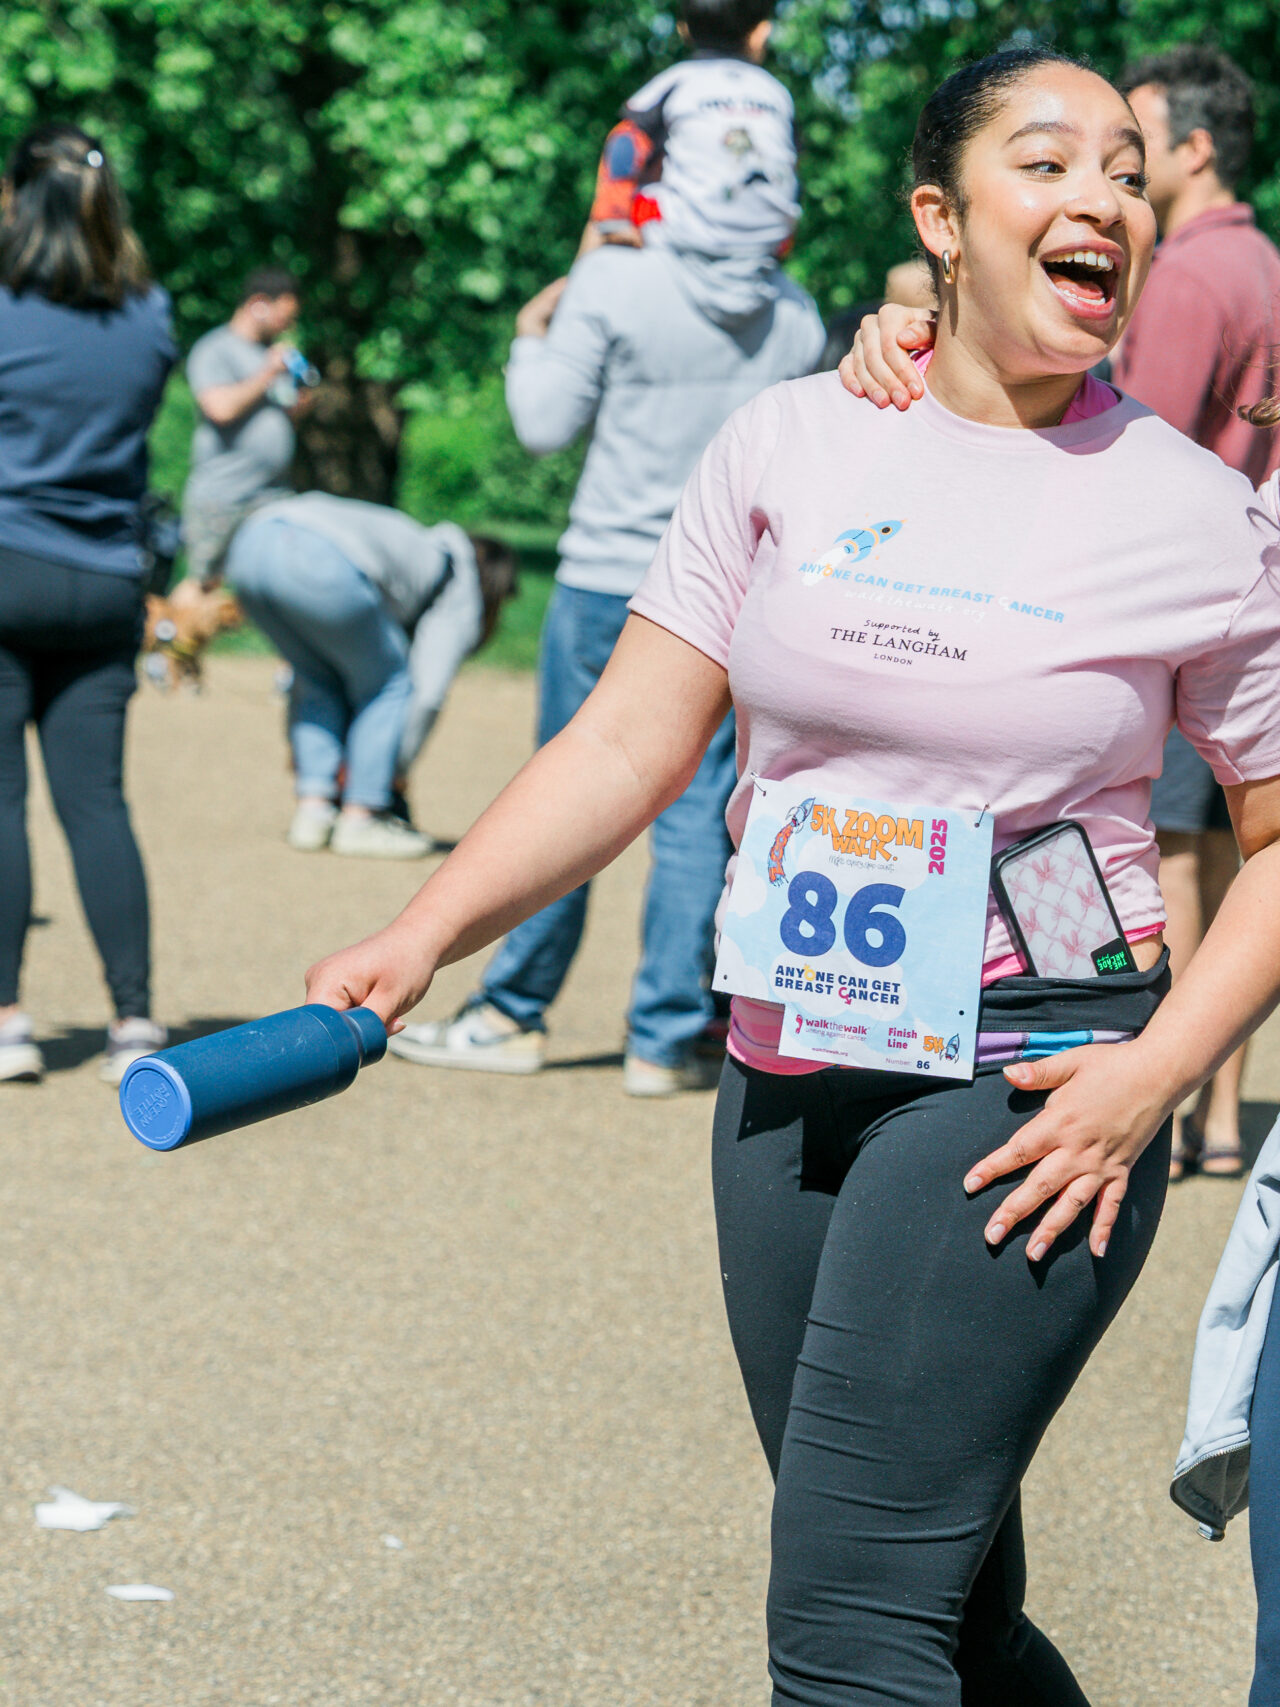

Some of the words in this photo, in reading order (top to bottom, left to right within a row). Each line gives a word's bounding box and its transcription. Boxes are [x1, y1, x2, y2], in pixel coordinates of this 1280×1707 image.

[798, 562, 851, 581] ANYONE
[854, 573, 888, 588] CAN
[893, 582, 926, 595] GET
[929, 586, 995, 605] BREAST
[998, 596, 1065, 623] CANCER
[864, 619, 921, 635] Supported
[928, 628, 940, 642] by
[830, 627, 867, 644] THE
[872, 635, 968, 661] LANGHAM
[873, 653, 913, 665] LONDON
[810, 804, 841, 838] 5K
[842, 809, 924, 850] ZOOM
[928, 819, 948, 875] 2025
[780, 870, 907, 968] 86
[775, 977, 834, 995] BREAST
[838, 987, 899, 1005] CANCER
[776, 964, 834, 983] ANYONE
[838, 975, 867, 988] CAN
[872, 979, 900, 993] GET
[847, 1033, 867, 1041] cancer
[887, 1039, 908, 1050] Line
[888, 1027, 918, 1040] Finish
[923, 1035, 944, 1054] 5K
[916, 1060, 930, 1070] 86
